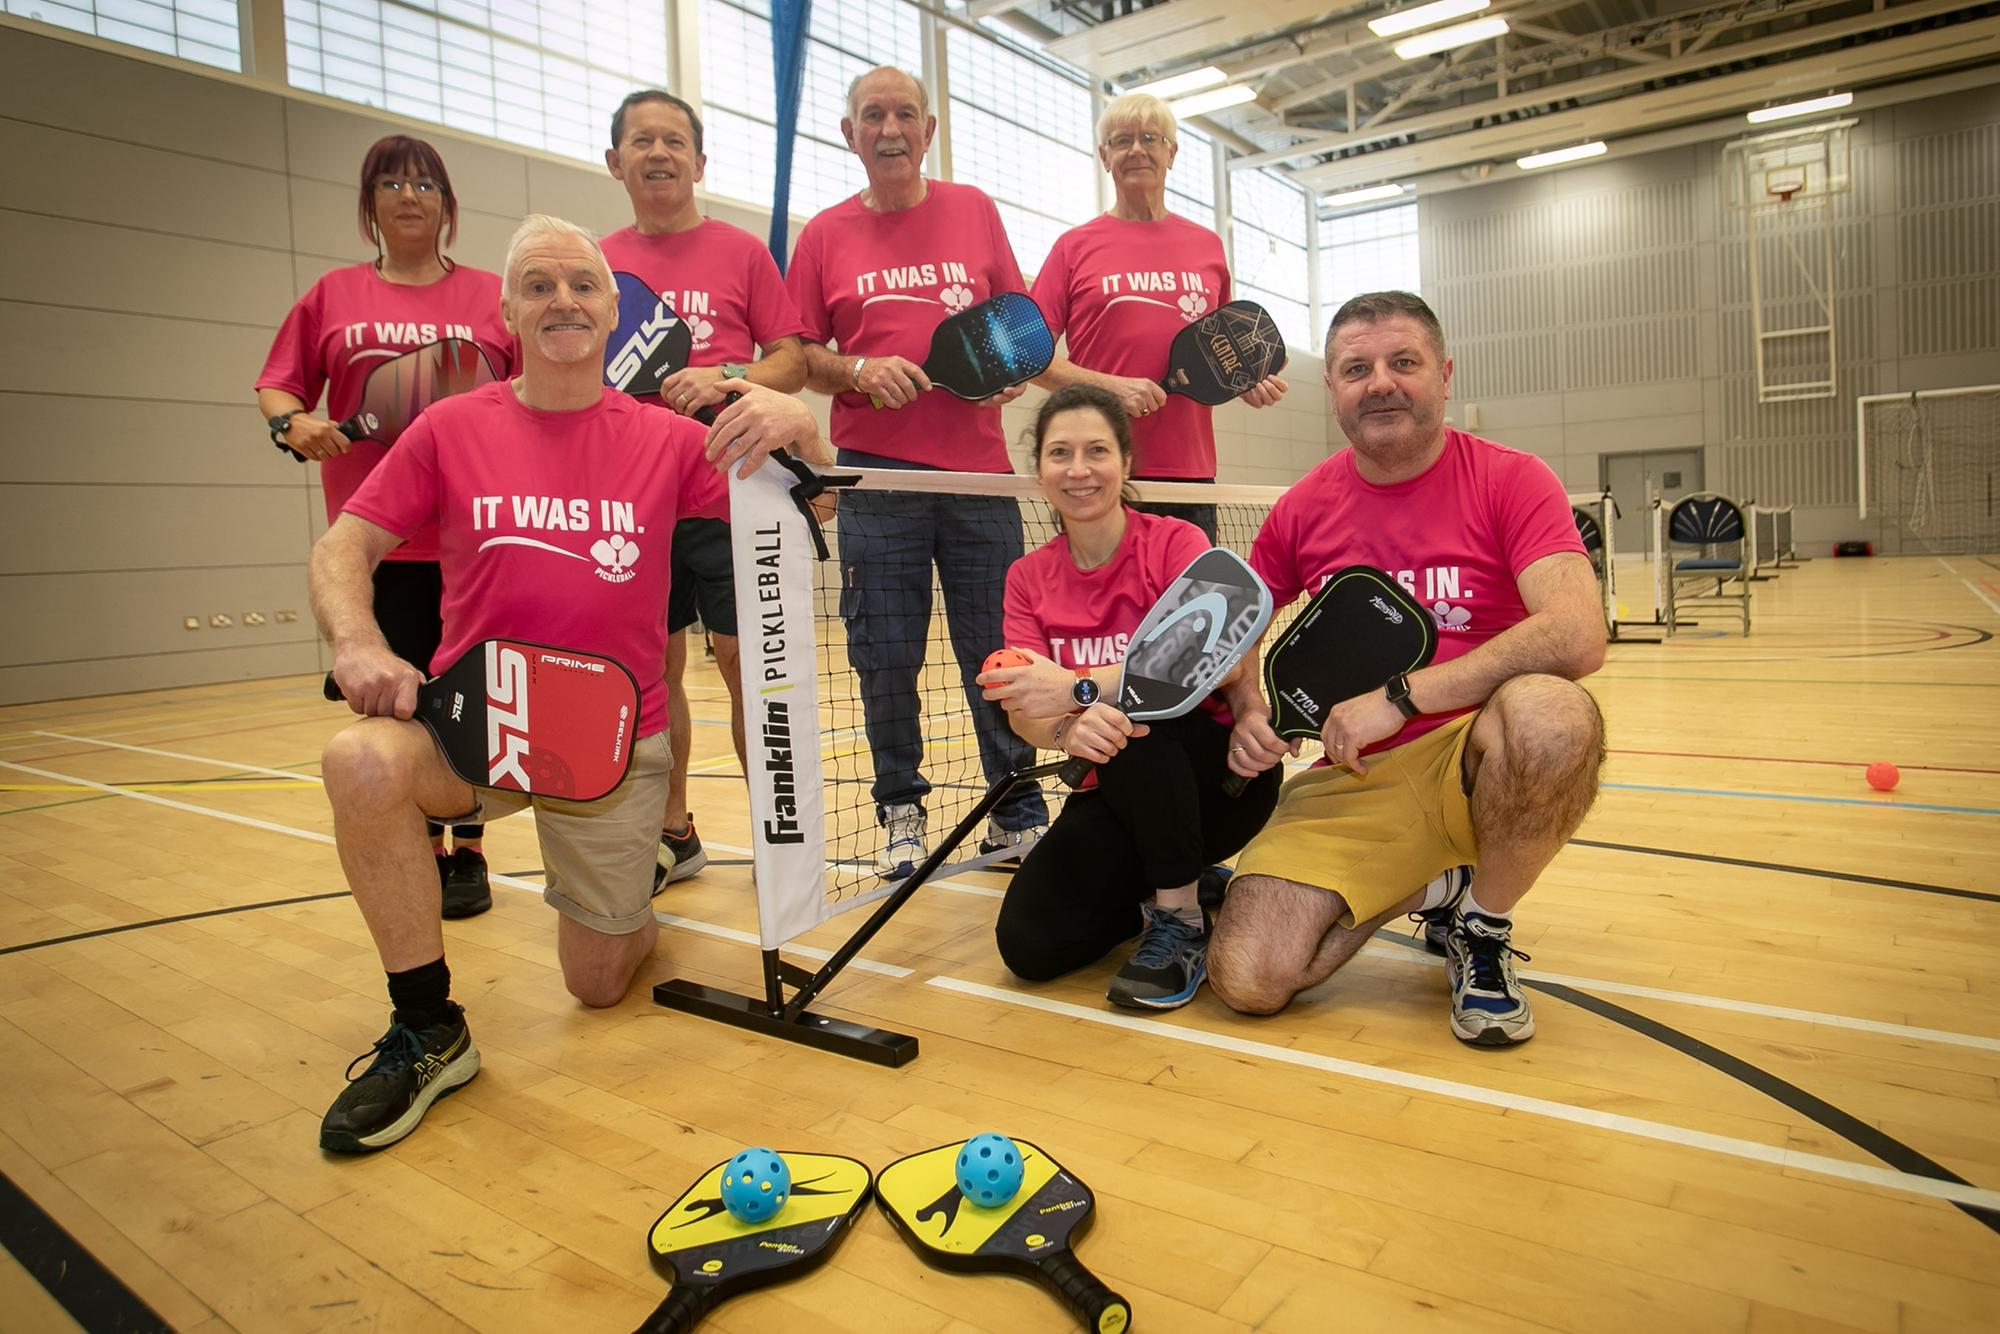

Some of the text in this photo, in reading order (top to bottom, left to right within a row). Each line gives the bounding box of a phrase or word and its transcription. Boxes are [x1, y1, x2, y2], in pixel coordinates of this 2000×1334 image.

[857, 262, 975, 295] IT WAS IN.
[1102, 272, 1210, 295] IT WAS IN.
[683, 290, 717, 316] IN.
[345, 322, 476, 348] IT WAS IN
[606, 301, 679, 391] SLK
[1211, 335, 1242, 375] CENTRE
[473, 496, 645, 534] IT WAS IN.
[594, 567, 636, 583] PICKLEBALL
[1426, 566, 1473, 600] IN.
[541, 655, 605, 672] PRIME
[1050, 638, 1065, 665] T
[1072, 633, 1128, 665] WAS
[755, 521, 804, 844] Franklin PICKLEBALL
[1127, 686, 1143, 704] HEAD
[451, 691, 464, 722] SLK
[485, 641, 530, 792] SLK
[1292, 688, 1319, 714] T700
